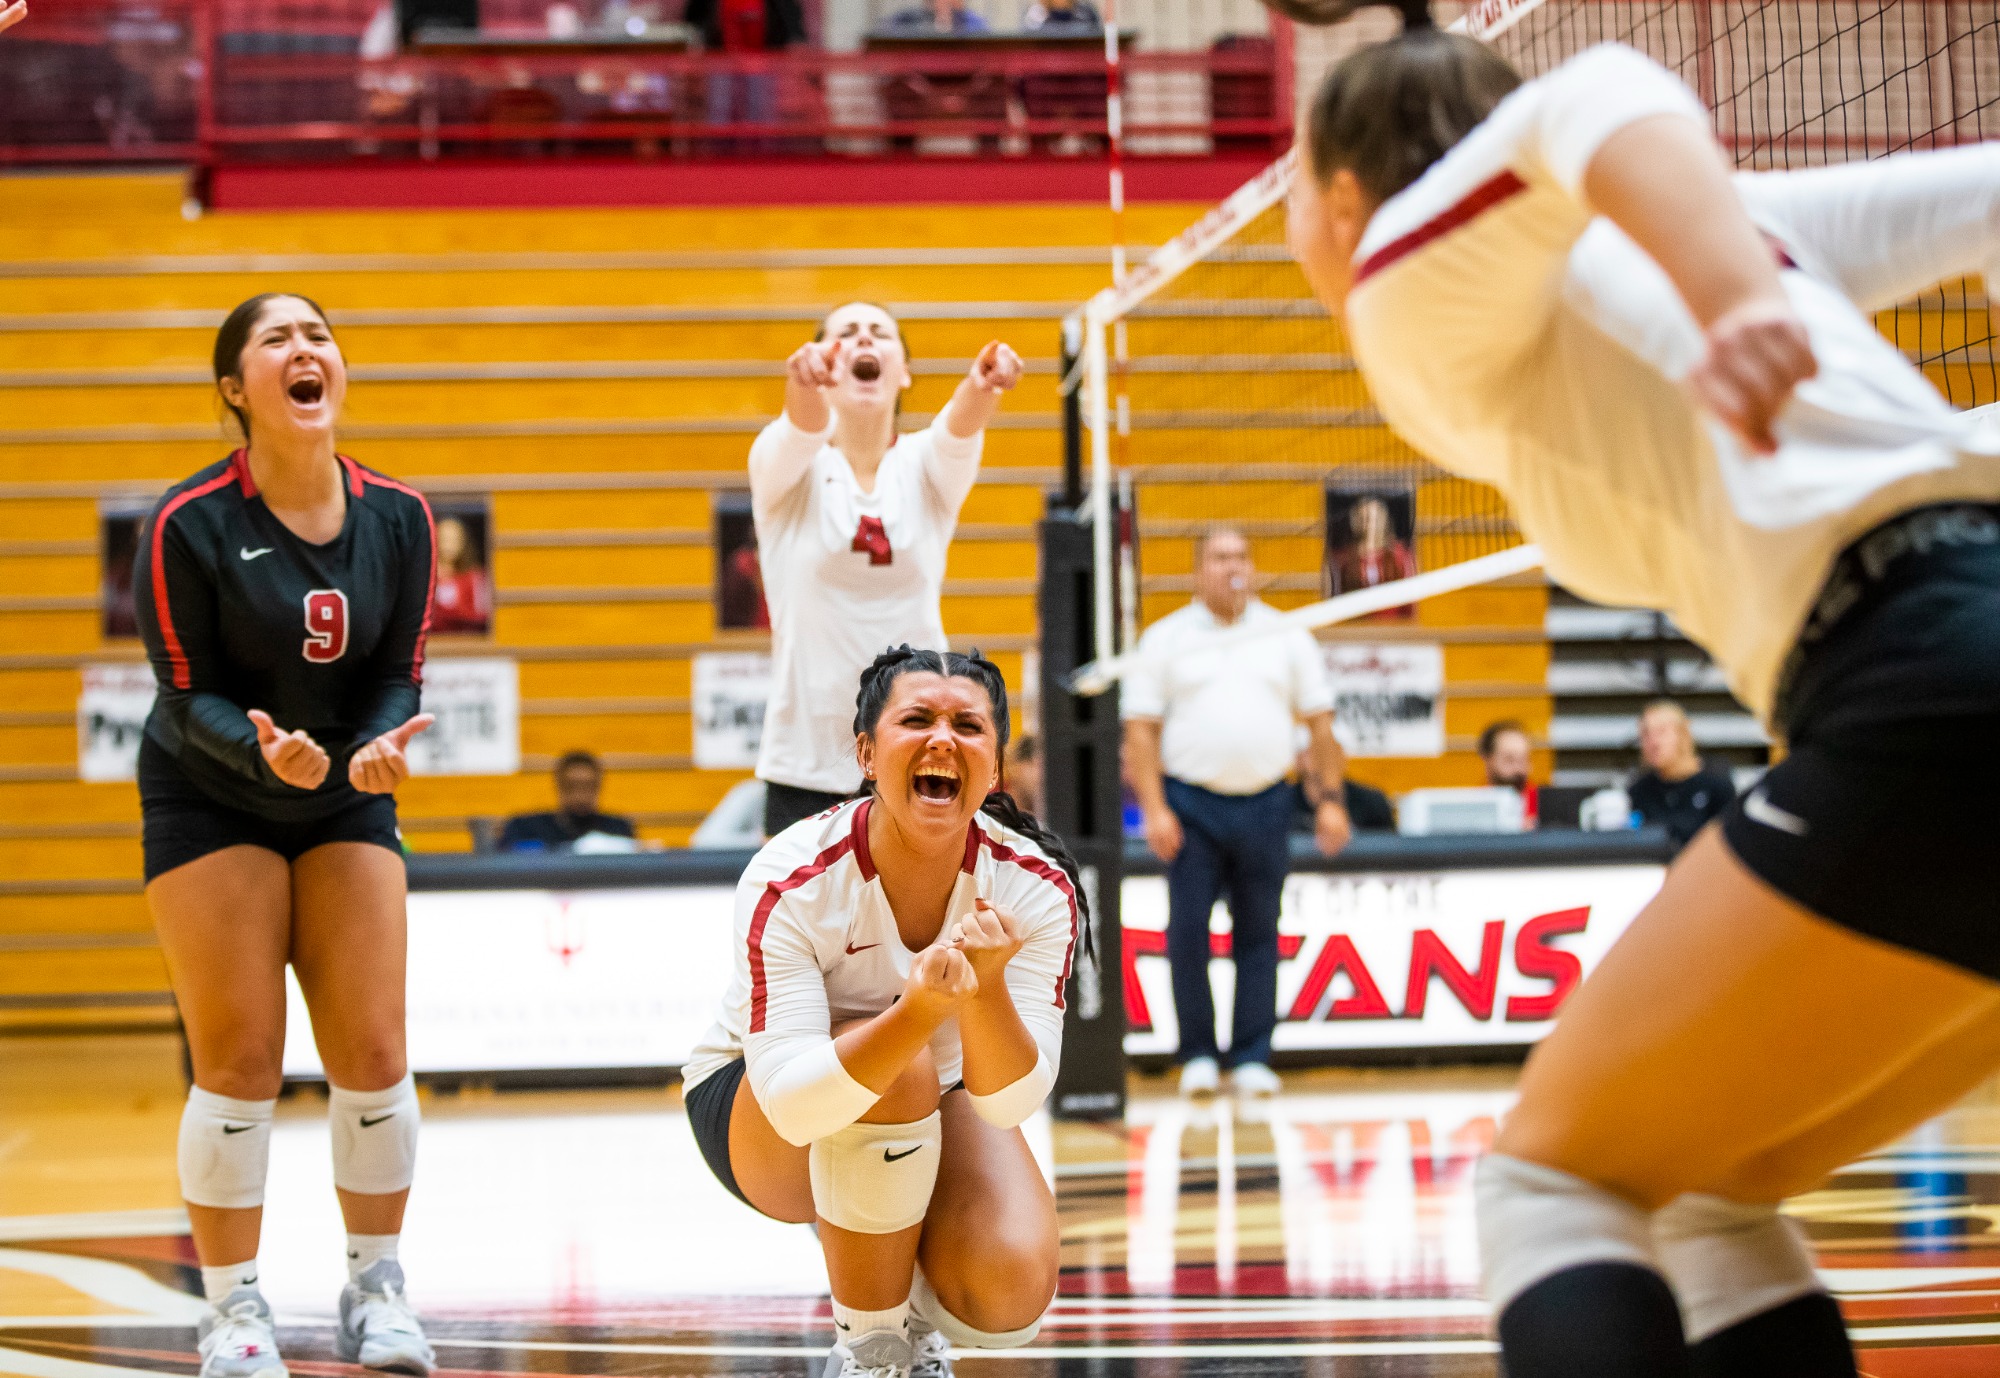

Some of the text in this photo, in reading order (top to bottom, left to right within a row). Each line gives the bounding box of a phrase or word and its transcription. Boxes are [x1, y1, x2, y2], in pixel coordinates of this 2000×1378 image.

[852, 515, 892, 566] 4
[302, 589, 349, 663] 9
[1121, 905, 1592, 1033] TANS
